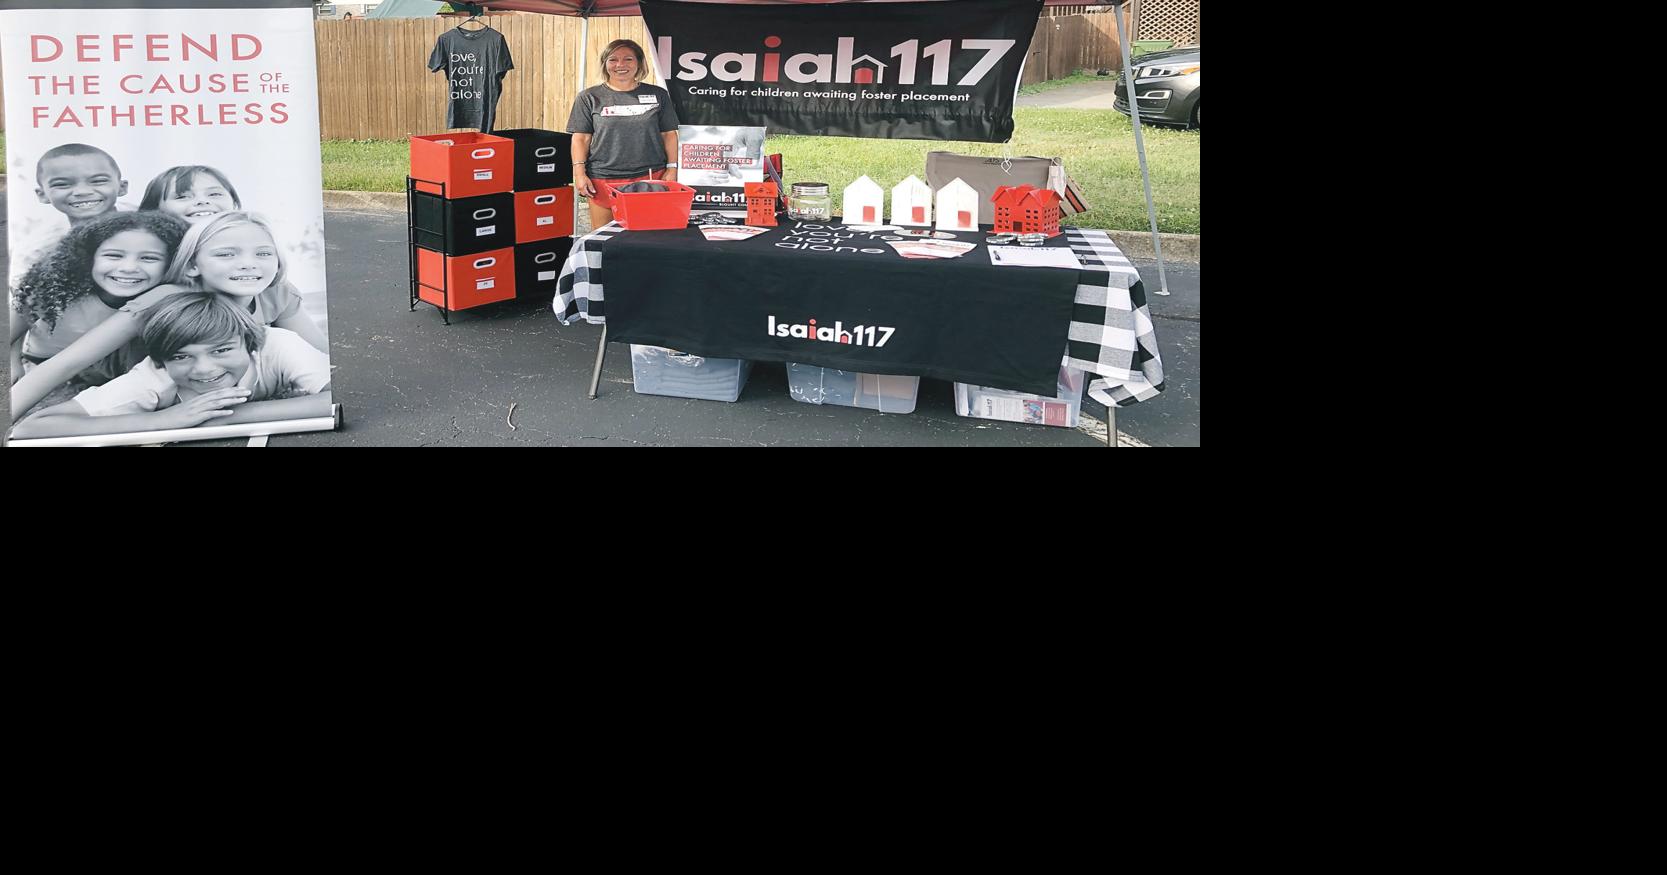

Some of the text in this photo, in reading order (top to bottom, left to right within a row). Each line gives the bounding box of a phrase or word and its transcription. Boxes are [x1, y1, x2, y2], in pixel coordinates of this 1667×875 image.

[30, 32, 263, 63] DEFEND
[657, 35, 1016, 86] Isaiah117
[259, 72, 283, 83] OF
[450, 77, 473, 87] not
[28, 73, 250, 96] THE CAUSE
[259, 83, 290, 94] THE
[688, 86, 970, 102] Caring for children awaiting foster placement
[31, 102, 290, 129] FATHERLESS
[692, 191, 746, 203] aiah11
[794, 221, 847, 231] lov
[781, 235, 845, 245] not
[774, 242, 886, 255] alone
[767, 315, 896, 348] Isaiah117
